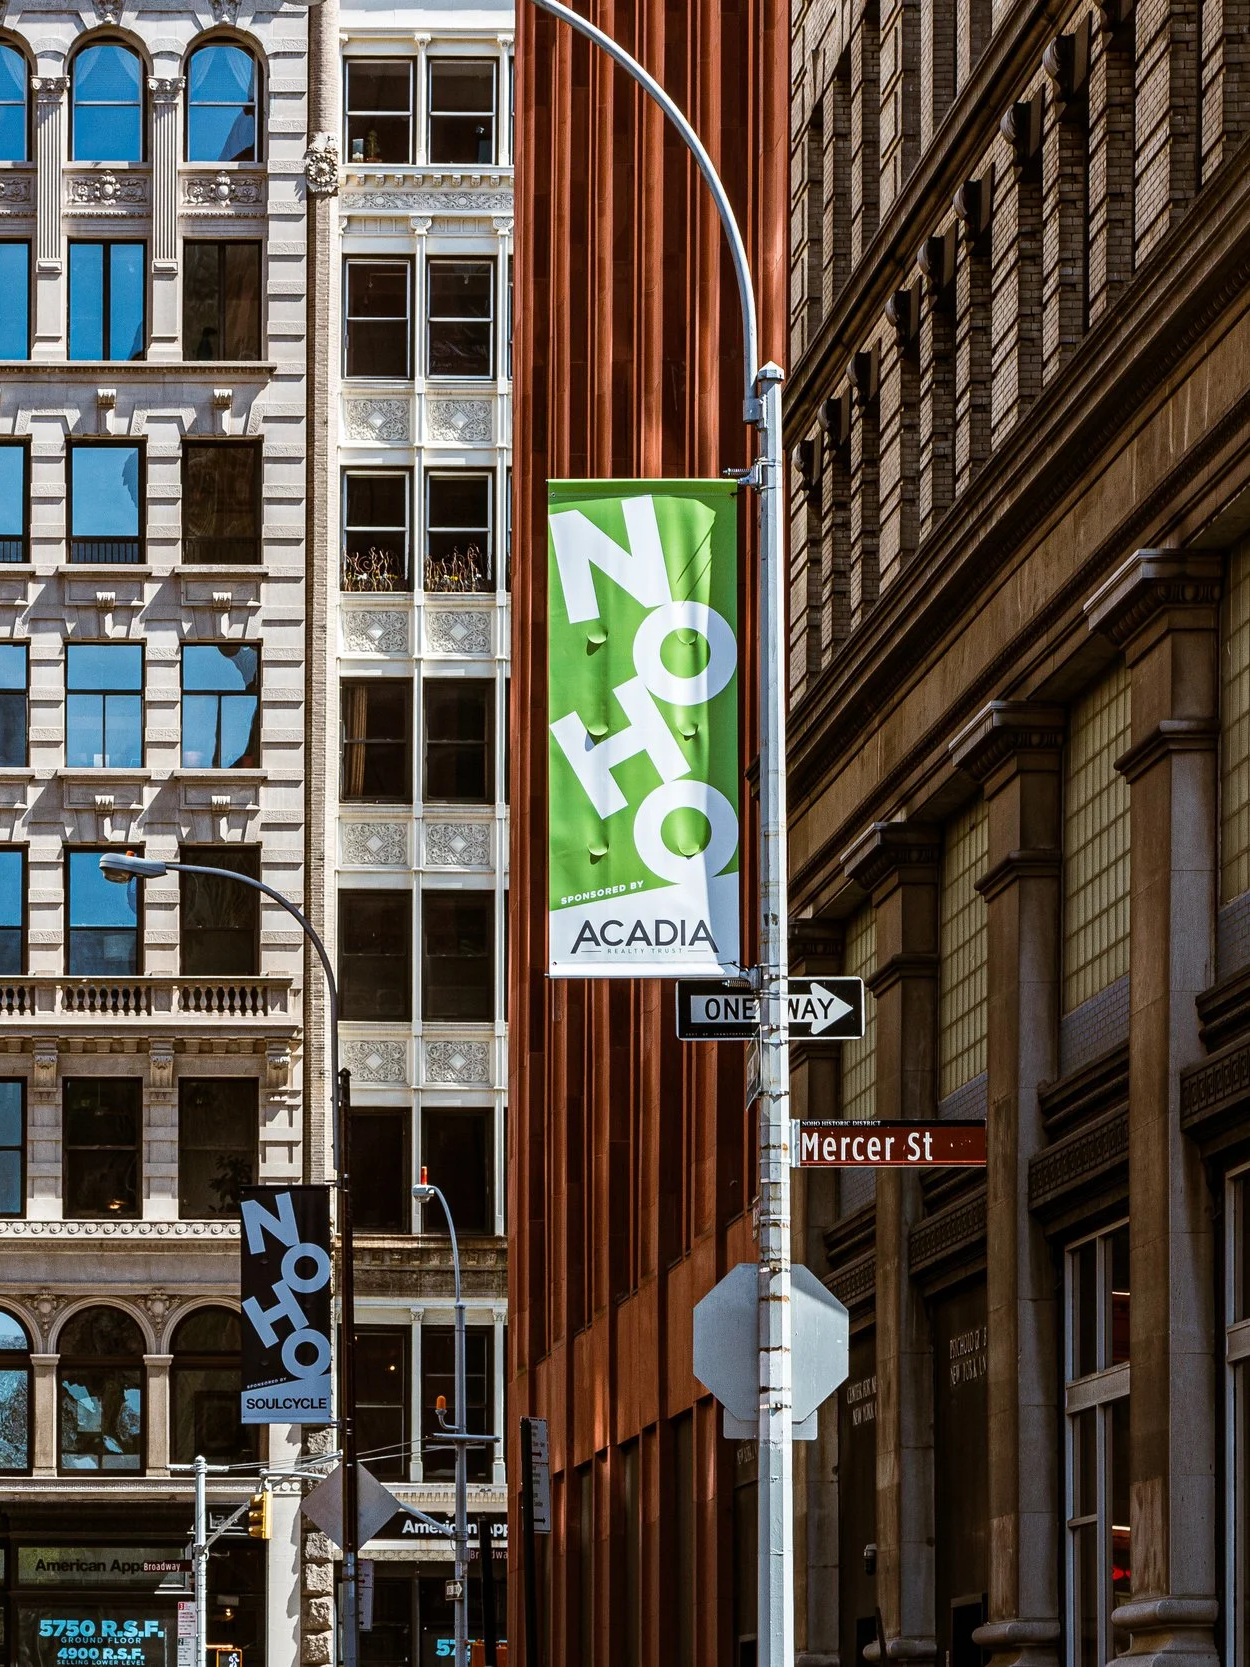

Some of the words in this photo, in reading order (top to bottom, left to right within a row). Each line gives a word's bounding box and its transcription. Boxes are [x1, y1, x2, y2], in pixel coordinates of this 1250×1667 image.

[549, 494, 738, 885] NOHO
[561, 884, 626, 905] SPONSORED
[630, 880, 644, 889] BY
[570, 920, 719, 954] ACADIA
[705, 998, 756, 1020] ONE
[801, 1132, 895, 1161] Mercer
[907, 1131, 933, 1161] St
[241, 1192, 330, 1379] NOHO
[246, 1379, 278, 1389] SPONSORED
[246, 1398, 327, 1409] SOULCYCLE
[35, 1559, 106, 1572] American
[144, 1562, 181, 1573] Broadway
[38, 1619, 96, 1637] 5750
[101, 1620, 164, 1637] R.S.F.
[57, 1648, 99, 1660] 4900
[102, 1648, 145, 1660] R.S.F.
